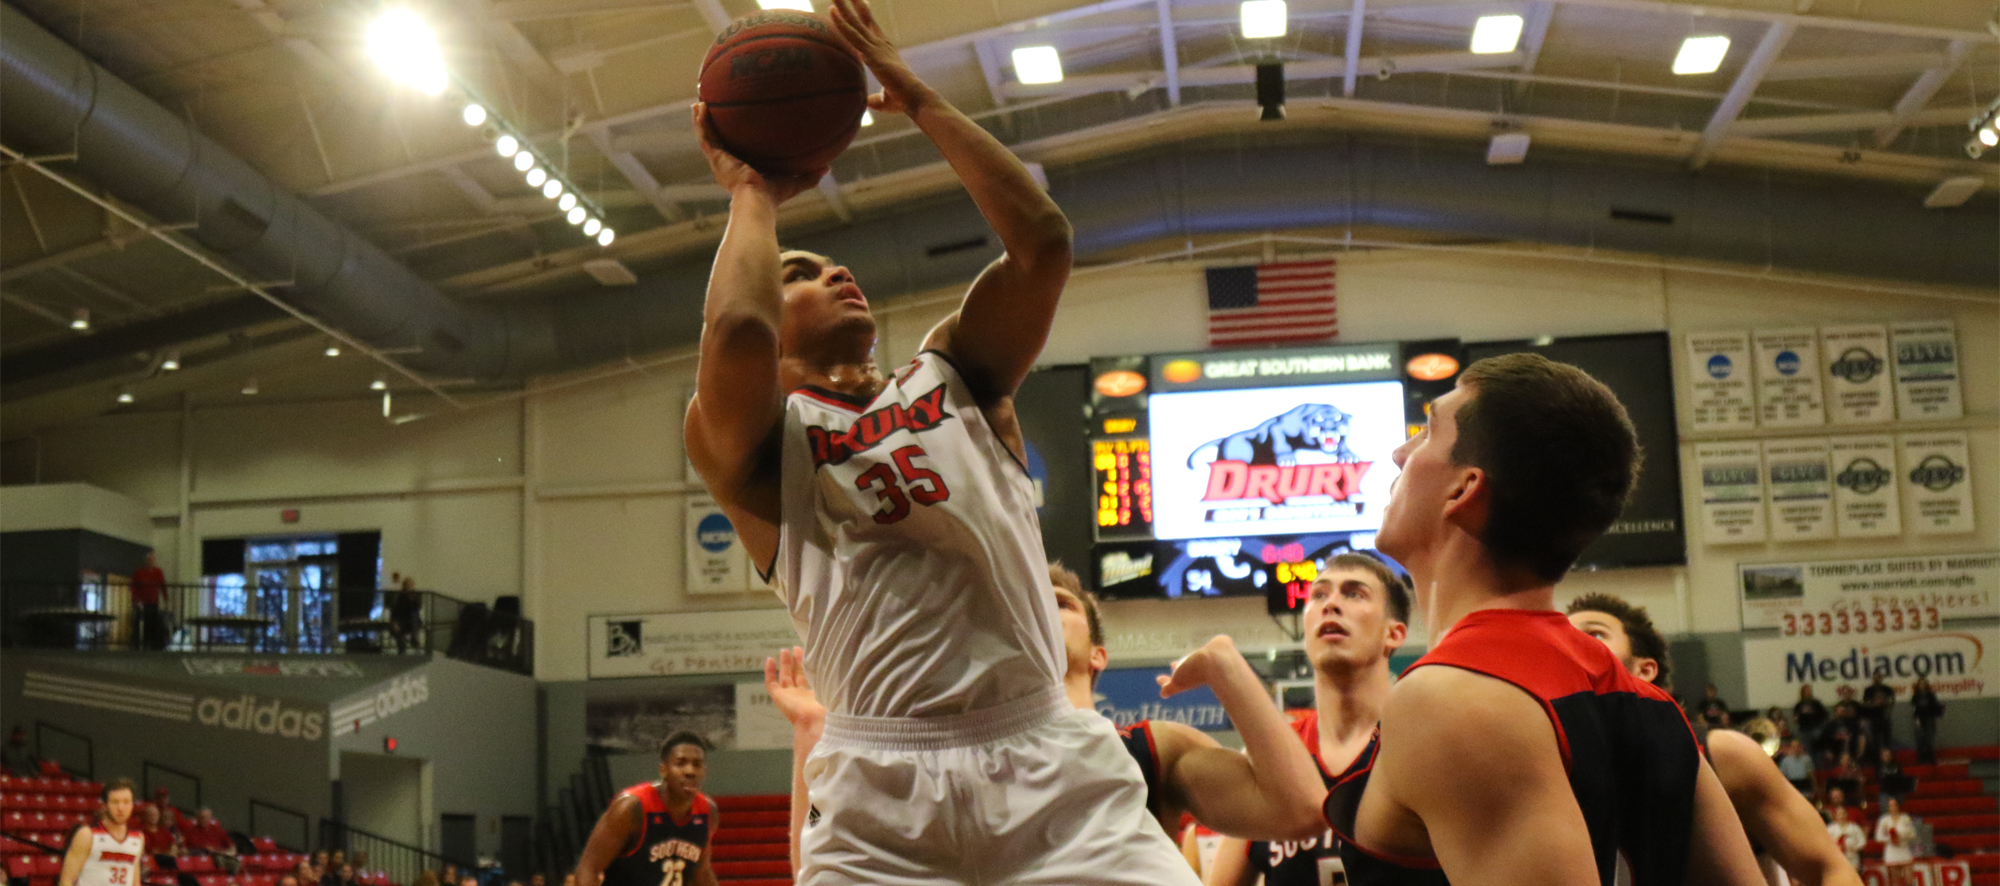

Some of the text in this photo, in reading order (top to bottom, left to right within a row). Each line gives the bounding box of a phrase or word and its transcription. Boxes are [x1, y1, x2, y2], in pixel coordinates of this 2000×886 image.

[1203, 361, 1258, 379] GREAT
[1259, 356, 1345, 377] SOUTHERN
[1345, 353, 1392, 372] BANK
[854, 444, 950, 524] 35
[1202, 459, 1375, 503] DRURY
[1276, 560, 1318, 584] 6:40
[1786, 648, 1966, 682] Mediacom
[375, 676, 429, 719] adidas
[198, 695, 323, 741] adidas
[1269, 829, 1343, 867] SOUT
[109, 866, 128, 885] 32
